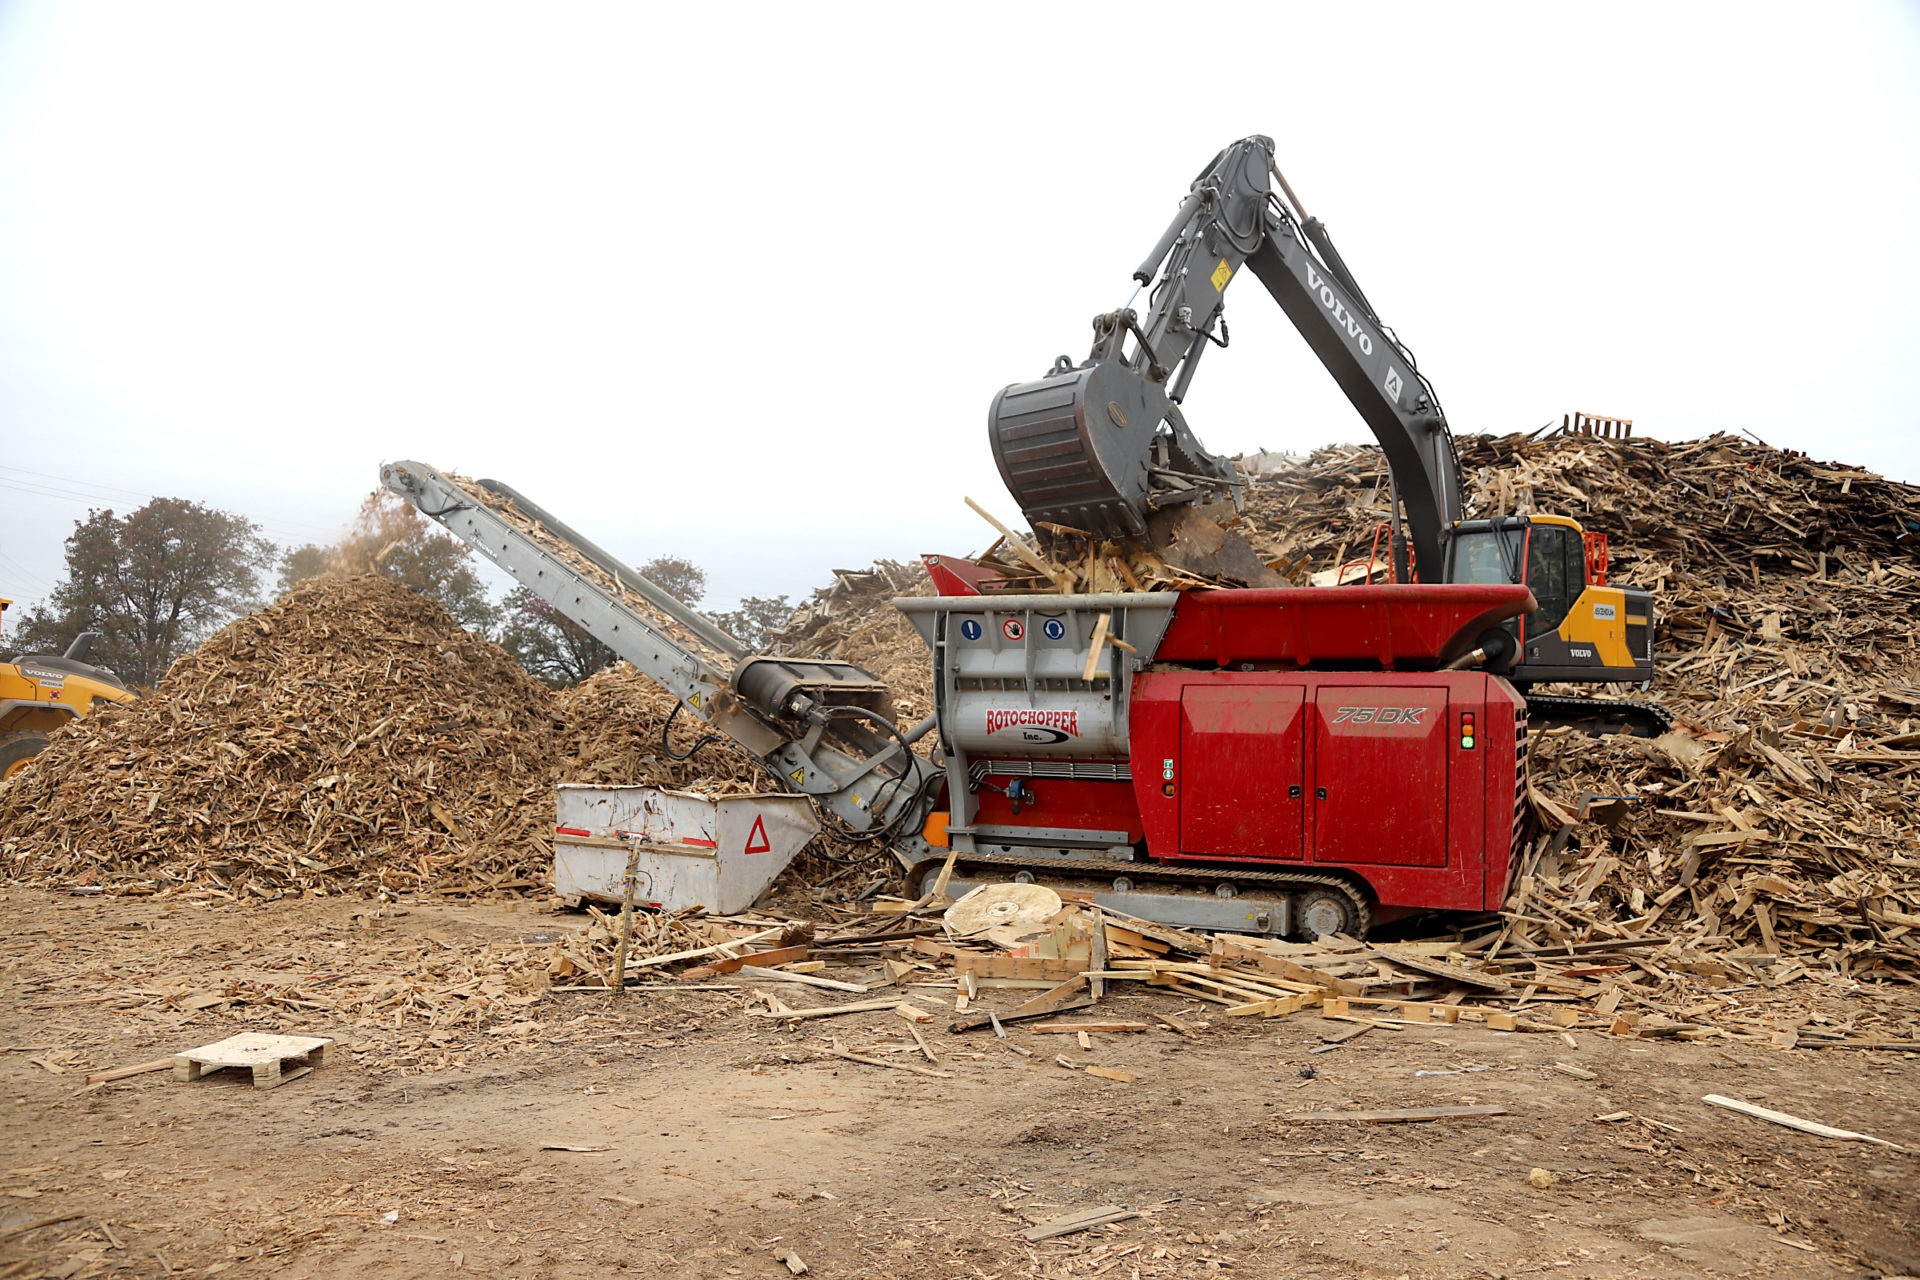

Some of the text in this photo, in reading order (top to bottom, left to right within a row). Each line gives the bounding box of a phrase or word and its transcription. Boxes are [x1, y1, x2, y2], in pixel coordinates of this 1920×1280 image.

[1305, 261, 1373, 356] VOLVO
[1570, 648, 1592, 658] VOLVO
[25, 669, 63, 679] VOLVO
[986, 709, 1079, 738] ROTOCHOPPER
[1022, 731, 1043, 741] Inc.
